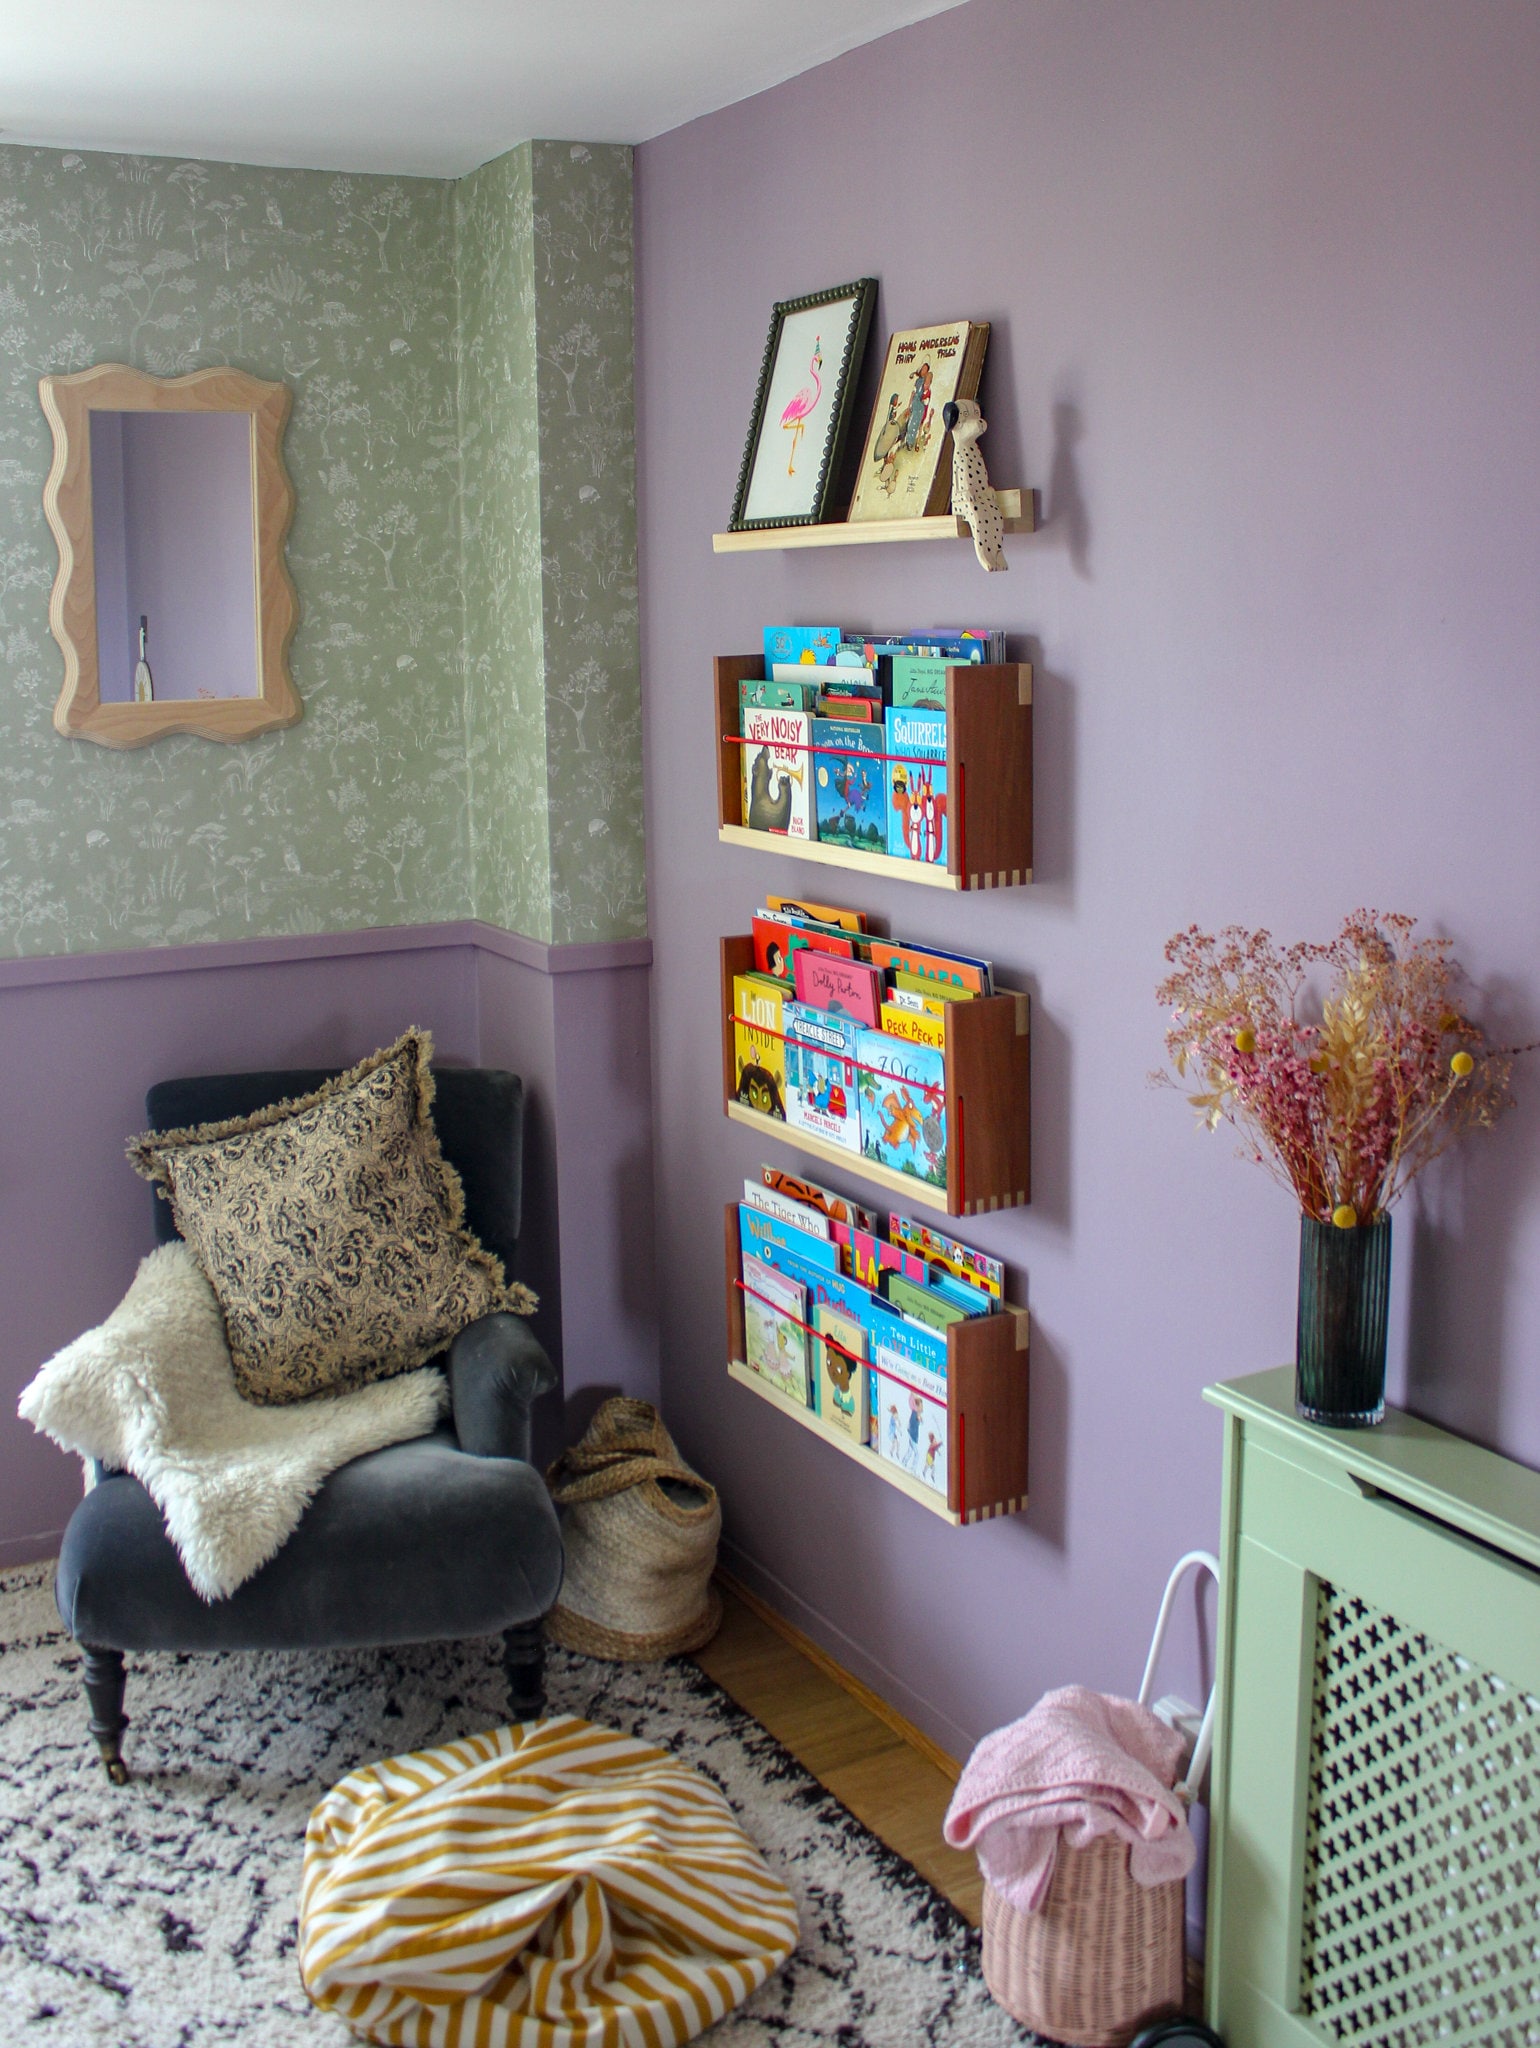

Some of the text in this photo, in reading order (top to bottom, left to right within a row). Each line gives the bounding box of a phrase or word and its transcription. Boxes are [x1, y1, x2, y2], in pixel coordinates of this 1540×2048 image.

[898, 341, 917, 353] HANS
[896, 354, 916, 365] FAIRY
[749, 716, 802, 743] VERY NOISY
[774, 741, 797, 764] BEAR
[835, 738, 844, 747] on
[845, 735, 856, 748] the
[913, 747, 947, 762] SQUABBLE
[813, 970, 862, 1001] Dolly Parton
[743, 1024, 776, 1051] INSIDE
[821, 1029, 843, 1047] STREET
[886, 1018, 908, 1036] PECK
[911, 1021, 934, 1047] PECK
[878, 1055, 919, 1084] ZOG
[752, 1191, 821, 1236] The Tiger Who
[831, 1278, 846, 1295] HUG
[833, 1324, 848, 1344] Ella
[890, 1326, 937, 1359] Ten Little
